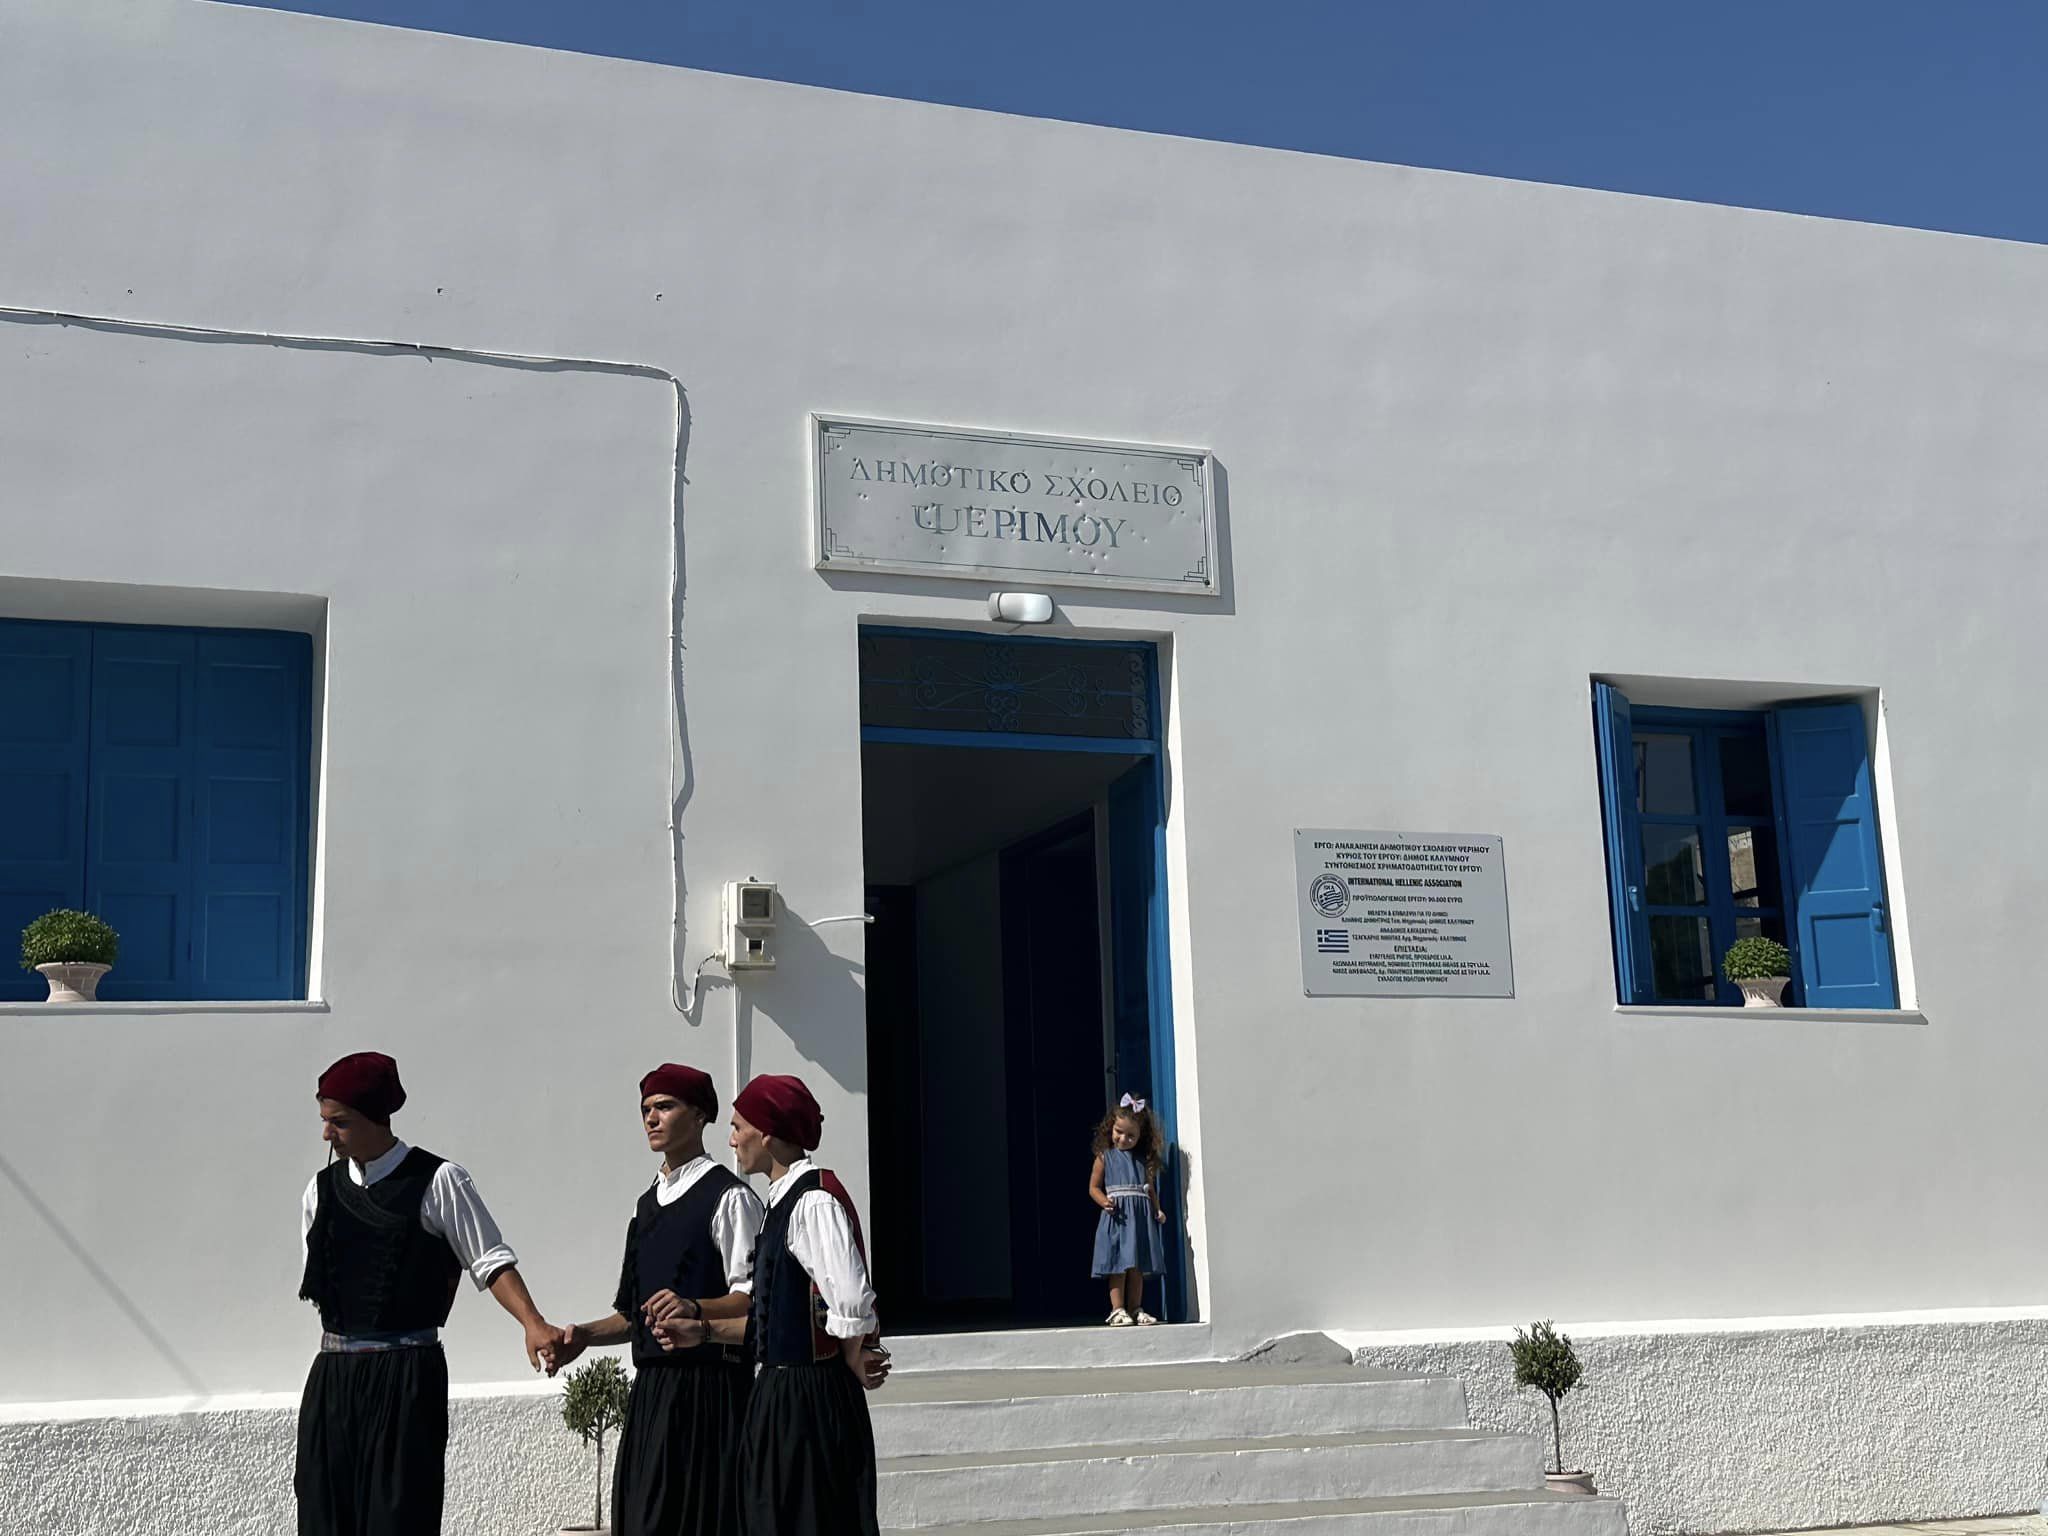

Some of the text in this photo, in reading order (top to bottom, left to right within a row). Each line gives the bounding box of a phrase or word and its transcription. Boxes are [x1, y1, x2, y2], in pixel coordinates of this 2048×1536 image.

[850, 457, 1182, 506] ΔΗΜΟΤΙΚΟ ΣΧΟΛΕΙΟ
[912, 503, 1126, 548] ΨΕΡΙΜΟΥ
[1380, 843, 1421, 851] ΔΗΜΟΤΙΚΟΥ
[1336, 852, 1362, 860] ΚΥΡΙΟΣ
[1444, 864, 1458, 872] ΤΟΥ
[1348, 877, 1463, 888] INTERNATIONAL HELLENIC ASSOCIATION
